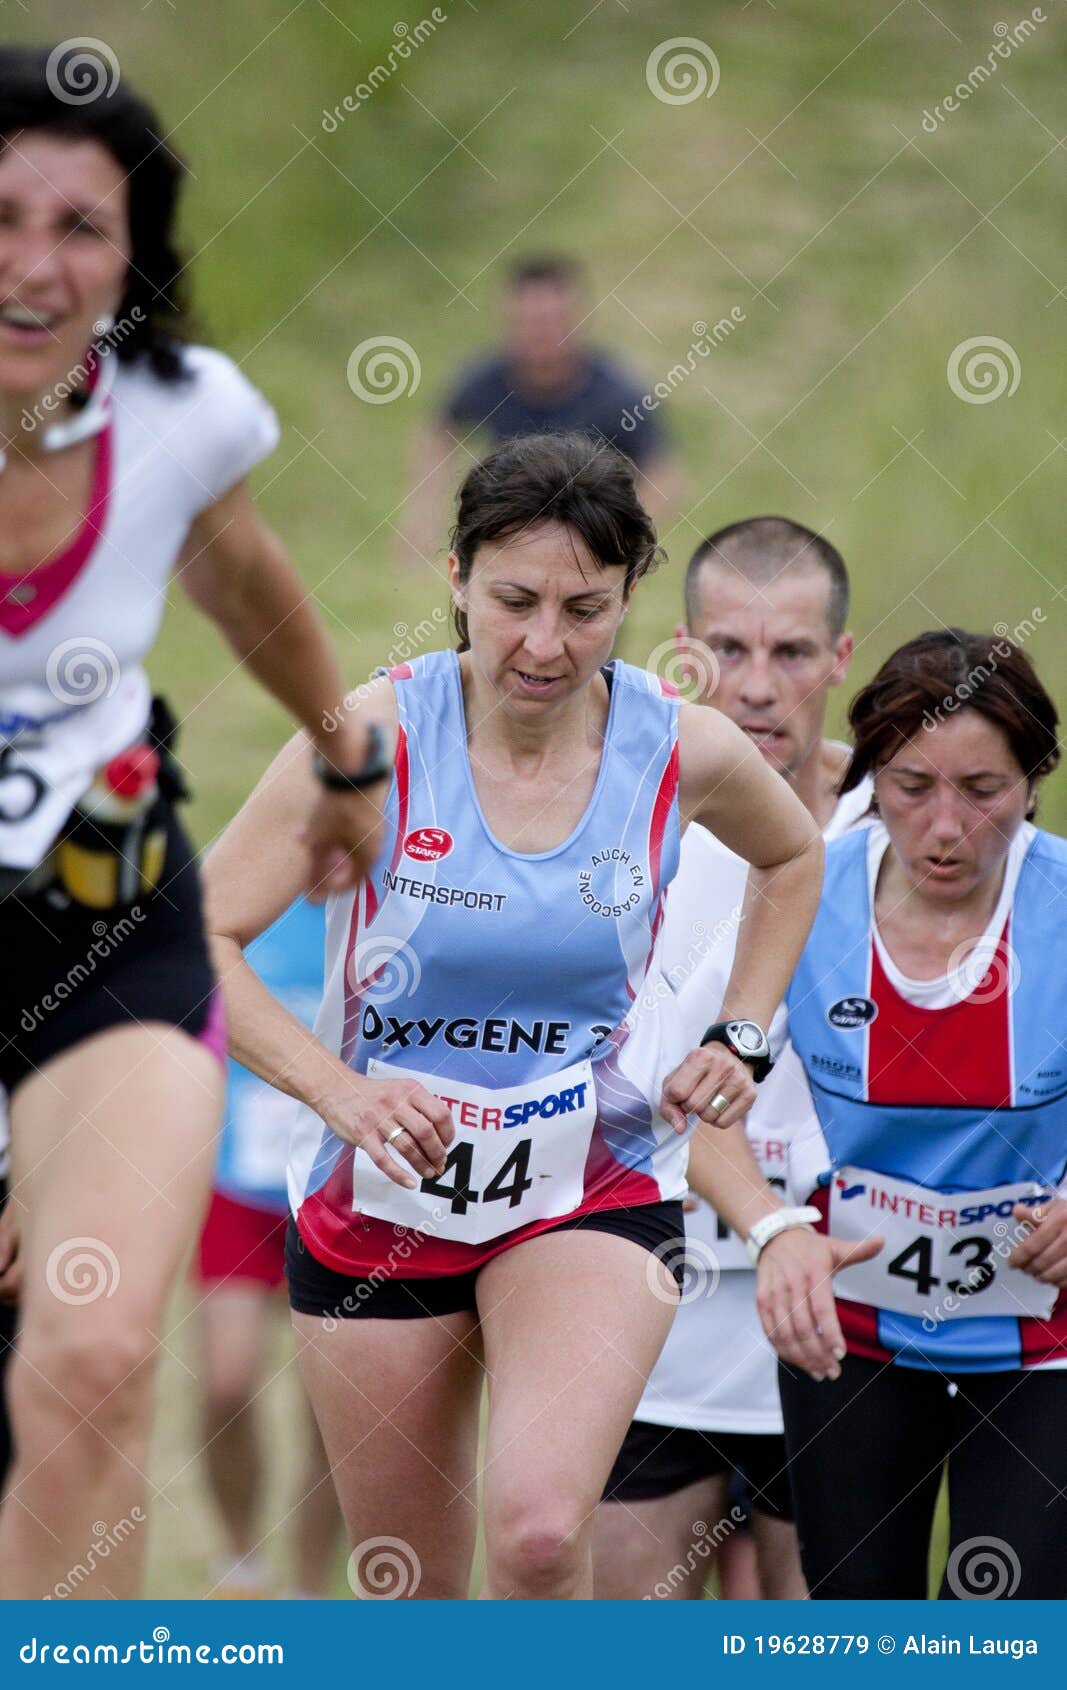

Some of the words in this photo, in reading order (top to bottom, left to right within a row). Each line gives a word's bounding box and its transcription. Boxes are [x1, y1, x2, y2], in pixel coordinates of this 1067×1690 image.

[407, 845, 443, 859] START
[591, 849, 631, 867] AUCH
[382, 868, 506, 911] INTERSPORT
[579, 871, 641, 917] GASCOGNE
[630, 865, 644, 887] EN
[362, 1004, 570, 1054] OXYGENE
[432, 1082, 588, 1131] TERSPORT
[420, 1138, 533, 1215] 44
[887, 1234, 997, 1297] 43
